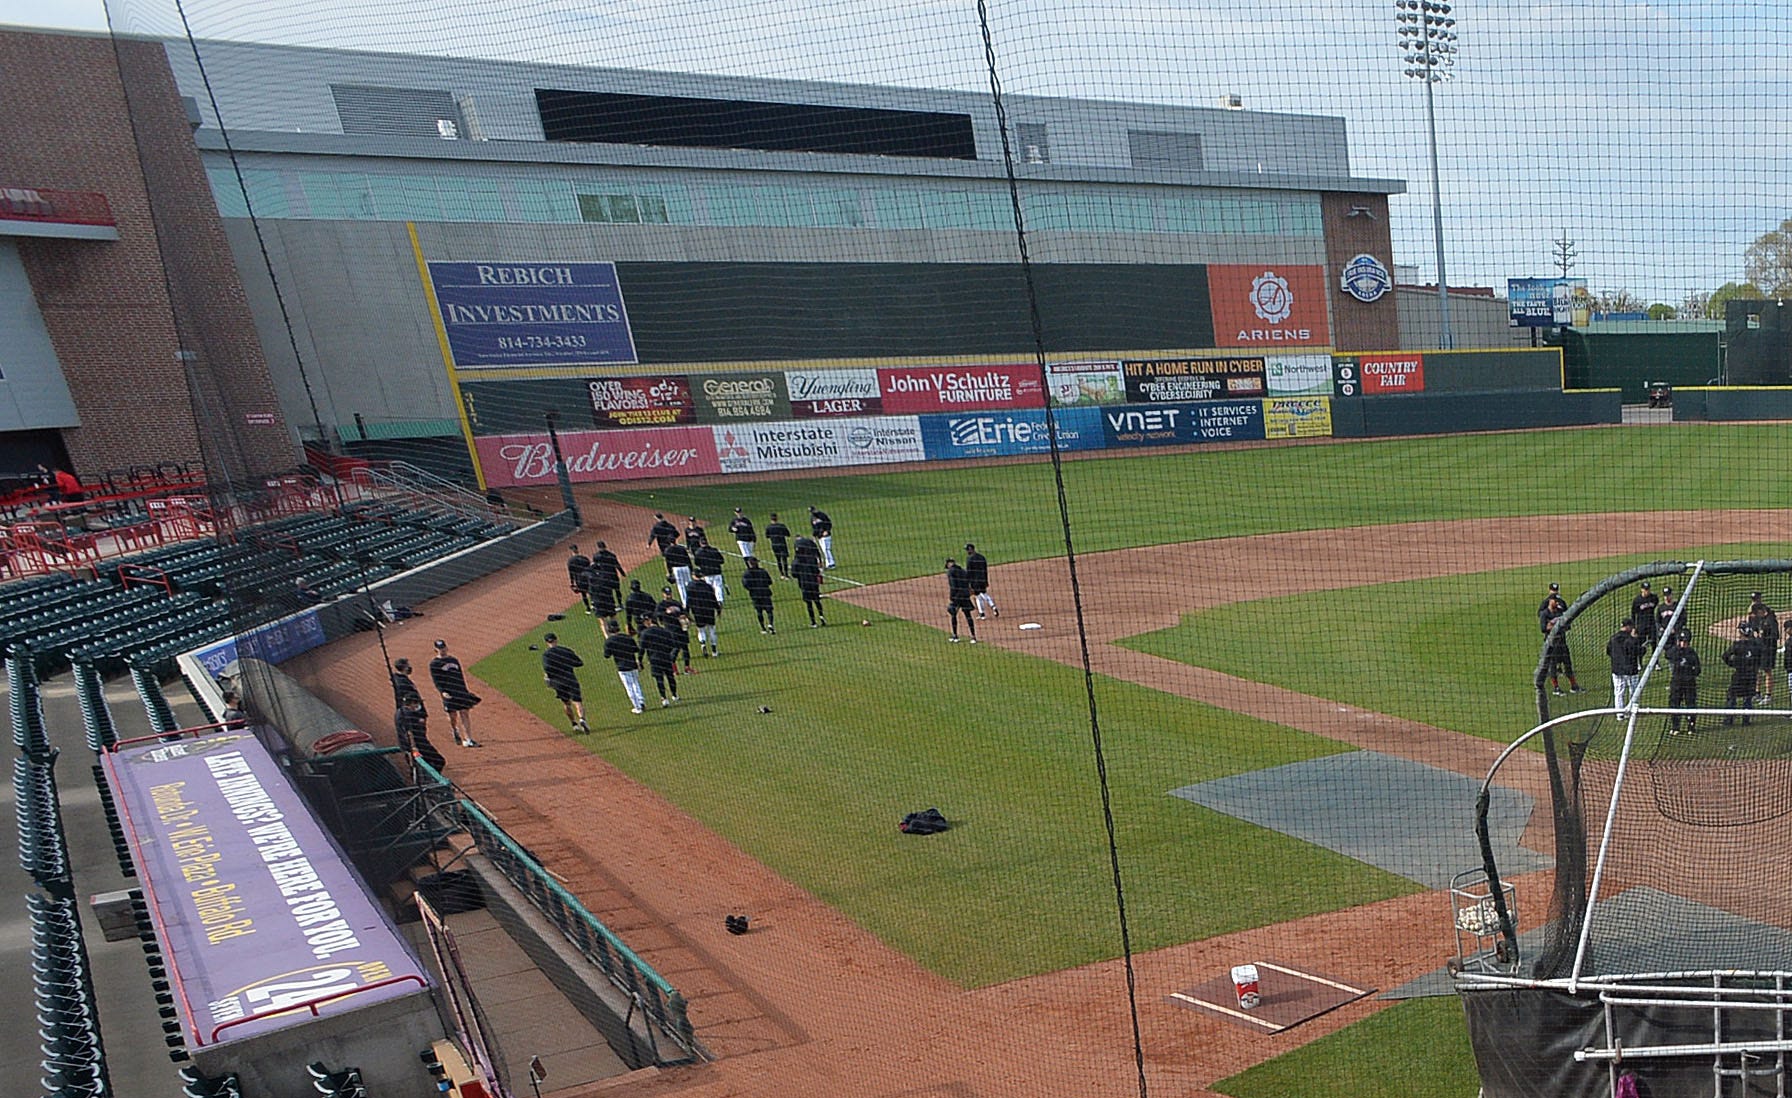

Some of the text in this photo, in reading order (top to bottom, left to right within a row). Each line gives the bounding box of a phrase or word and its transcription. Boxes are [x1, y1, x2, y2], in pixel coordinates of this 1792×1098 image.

[477, 265, 574, 285] REBICH
[446, 303, 620, 322] INVESTMENTS
[498, 336, 586, 349] 814-734-3433
[1237, 329, 1311, 341] ARIENS
[1125, 363, 1142, 376] HIT
[1146, 363, 1154, 375] A
[1156, 362, 1188, 375] HOME
[1190, 361, 1214, 374] RUN
[1215, 360, 1228, 373] IN
[1229, 360, 1263, 372] CYBER
[1284, 363, 1327, 373] Northwest
[1364, 361, 1418, 375] COUNTRY
[589, 381, 622, 392] OVER
[792, 376, 875, 398] Yuengling
[887, 375, 930, 393] John
[931, 374, 945, 389] V
[946, 372, 1011, 389] Schultz
[1140, 382, 1166, 392] CYBER
[1167, 380, 1221, 391] ENGINEERING
[1380, 374, 1406, 387] FAIR
[611, 389, 647, 400] WING
[939, 387, 1013, 403] FURNITURE
[1149, 390, 1213, 400] CYBERSECURITY
[594, 399, 649, 410] FLAVORS!
[812, 399, 863, 414] LAGER
[1199, 405, 1257, 417] IT SERVICES
[1201, 416, 1248, 427] INTERNET
[753, 427, 834, 443] Interstate
[978, 416, 1032, 444] Erie
[1201, 427, 1232, 437] VOICE
[756, 442, 838, 459] Mitsubishi
[171, 836, 214, 857] Erie
[204, 751, 361, 960] LATE INNINGS? WE'RE HERE FOR YOU.
[179, 852, 222, 882] Plaza
[191, 883, 246, 925] Buffalo
[205, 918, 257, 945] Rd.
[357, 960, 393, 983] OPEN
[246, 968, 359, 1014] 24
[208, 996, 245, 1024] SEVEN
